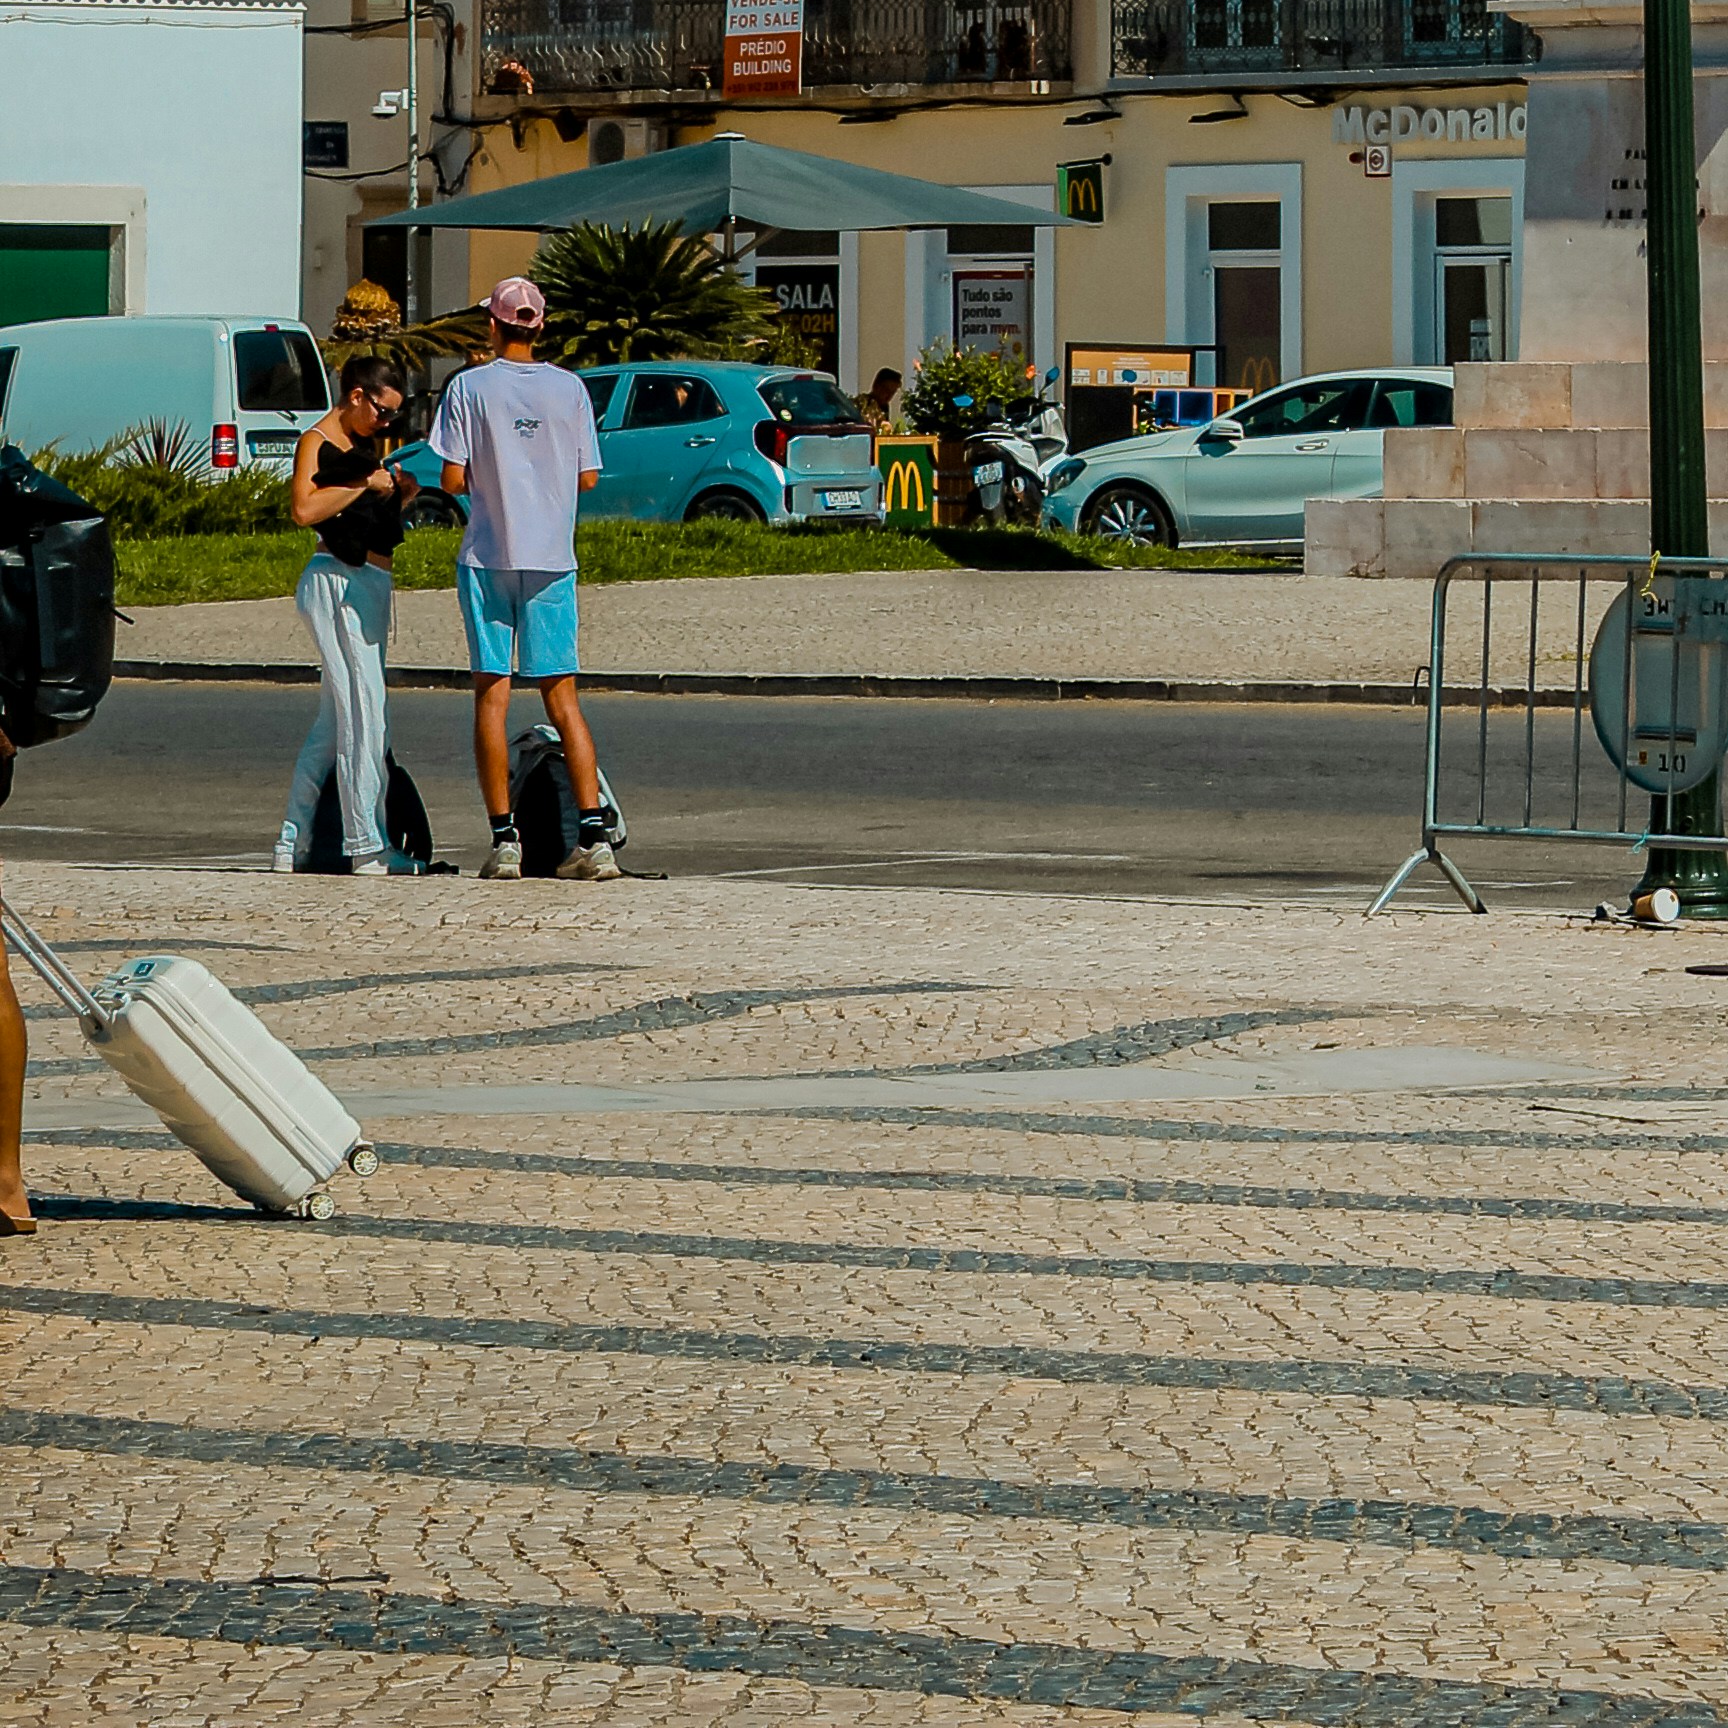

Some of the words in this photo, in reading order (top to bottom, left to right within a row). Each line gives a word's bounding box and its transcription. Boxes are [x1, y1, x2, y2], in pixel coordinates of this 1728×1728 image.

[729, 14, 757, 29] FOR
[764, 11, 799, 27] SALE
[740, 38, 786, 56] PRÉDIO
[733, 59, 792, 76] BUILDING
[776, 283, 835, 310] SALA
[961, 288, 990, 303] Tudo
[992, 287, 1013, 302] são
[961, 306, 1002, 321] pontos
[961, 324, 988, 338] para
